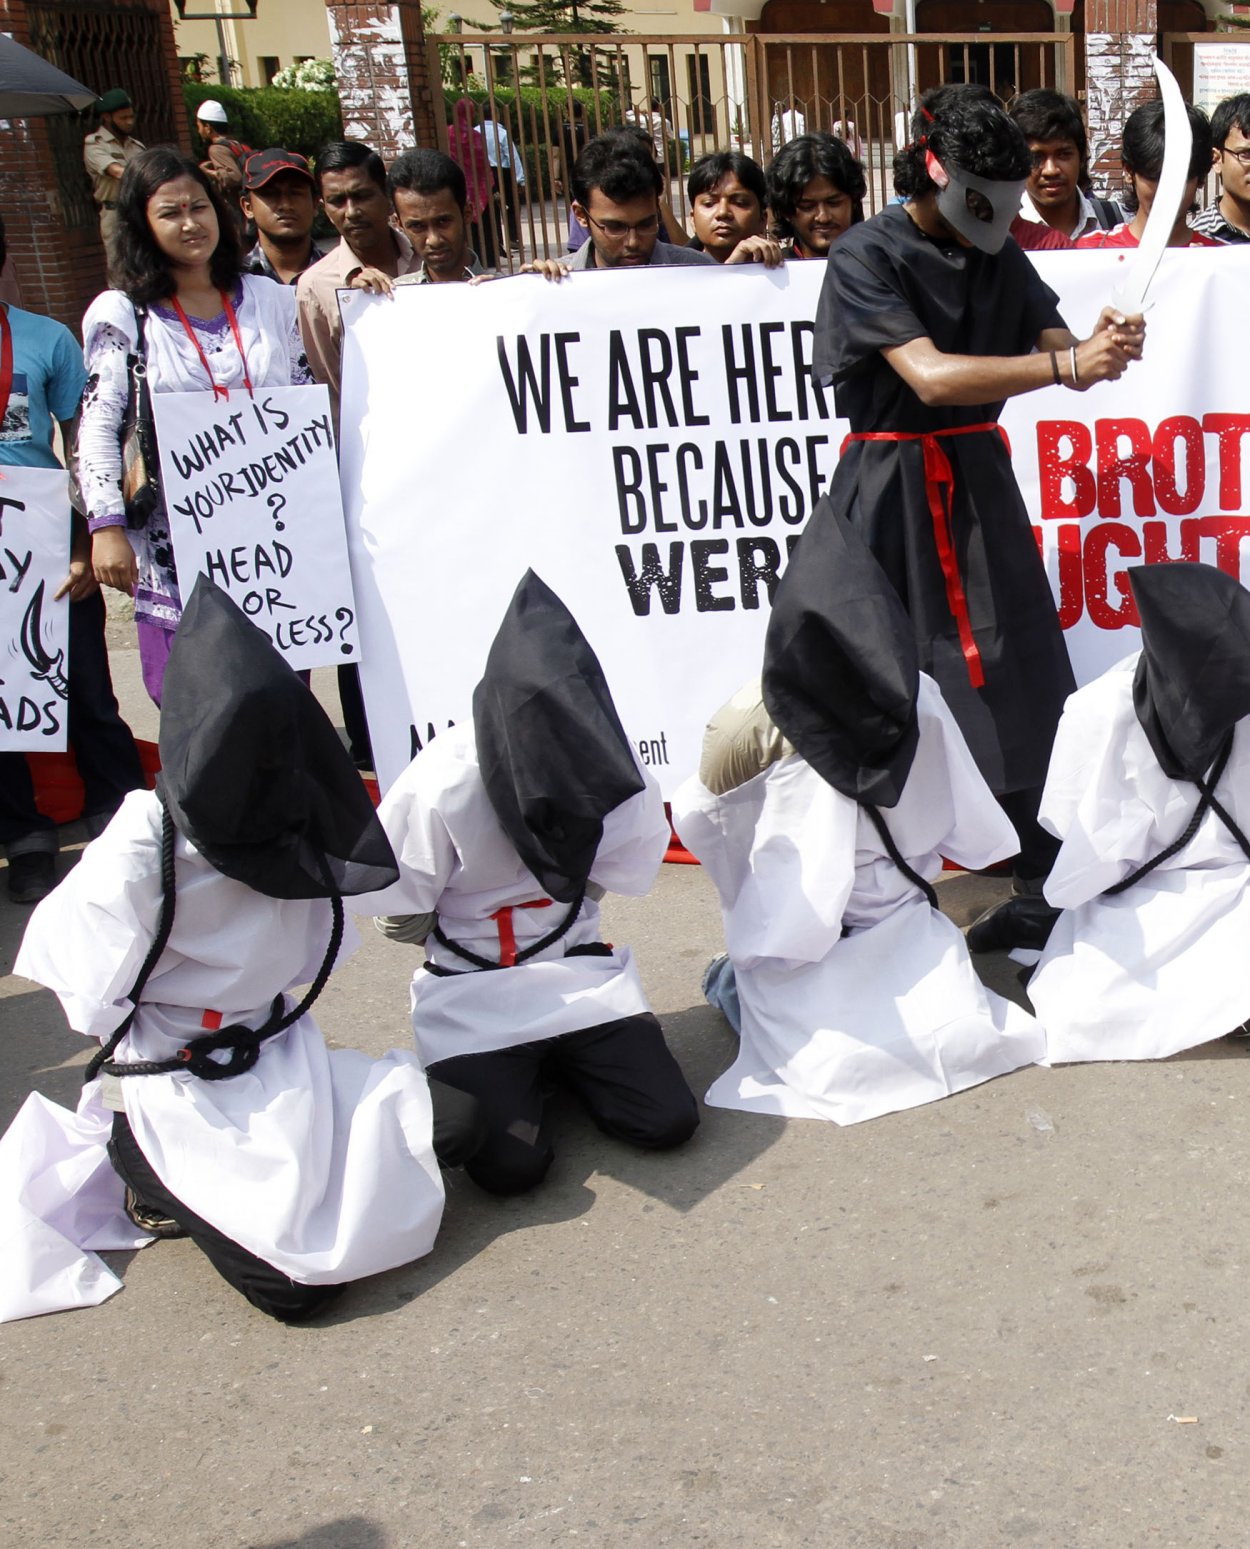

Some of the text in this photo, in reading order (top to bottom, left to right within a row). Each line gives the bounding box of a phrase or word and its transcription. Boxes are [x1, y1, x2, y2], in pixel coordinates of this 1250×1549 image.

[496, 320, 850, 435] WE ARE HER
[171, 396, 290, 480] WHAT IS
[610, 434, 829, 535] BECAUSE
[205, 540, 293, 589] HEAD
[242, 587, 297, 616] OR
[614, 534, 803, 617] WER
[261, 606, 355, 656] LESS?
